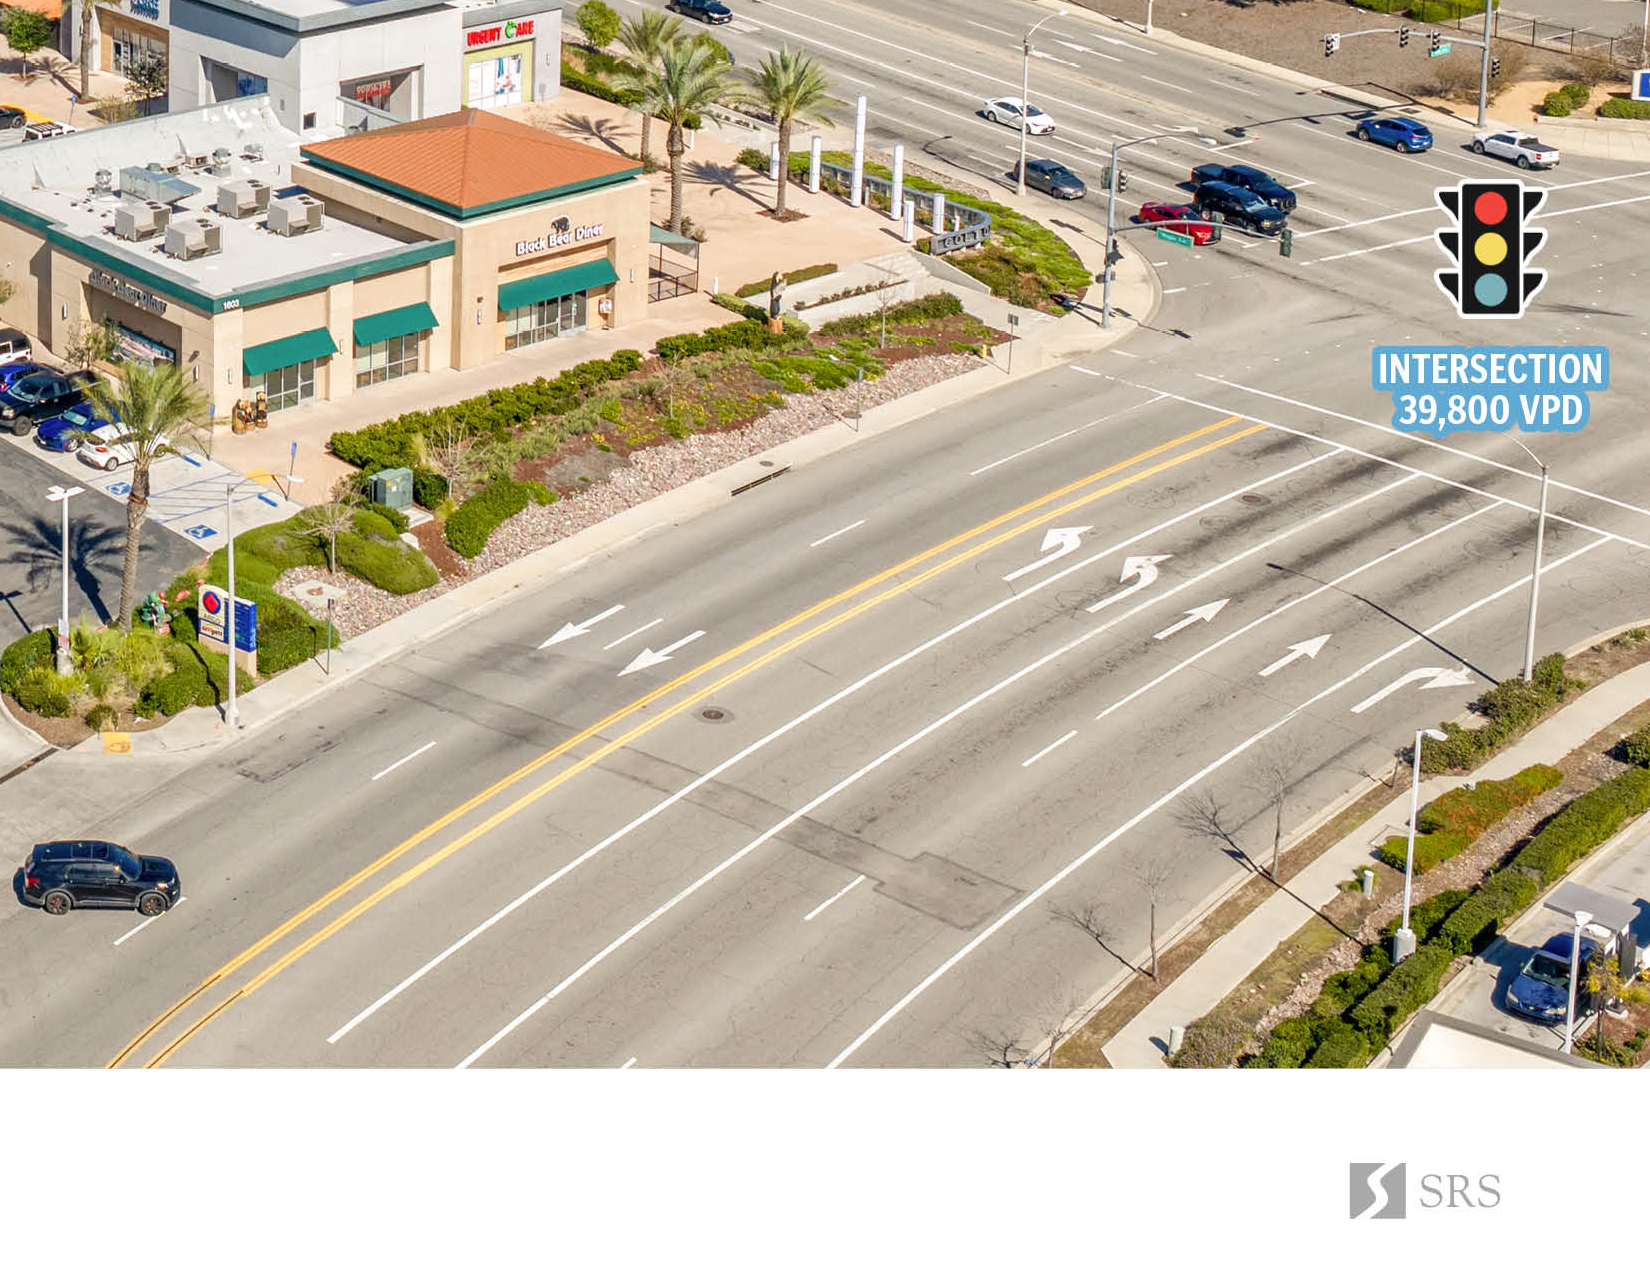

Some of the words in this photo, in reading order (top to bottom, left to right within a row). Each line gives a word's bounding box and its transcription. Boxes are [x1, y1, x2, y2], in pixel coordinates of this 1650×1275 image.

[467, 27, 502, 46] URGENT
[516, 237, 546, 256] Black
[548, 231, 574, 248] Bear
[575, 224, 603, 241] Diner
